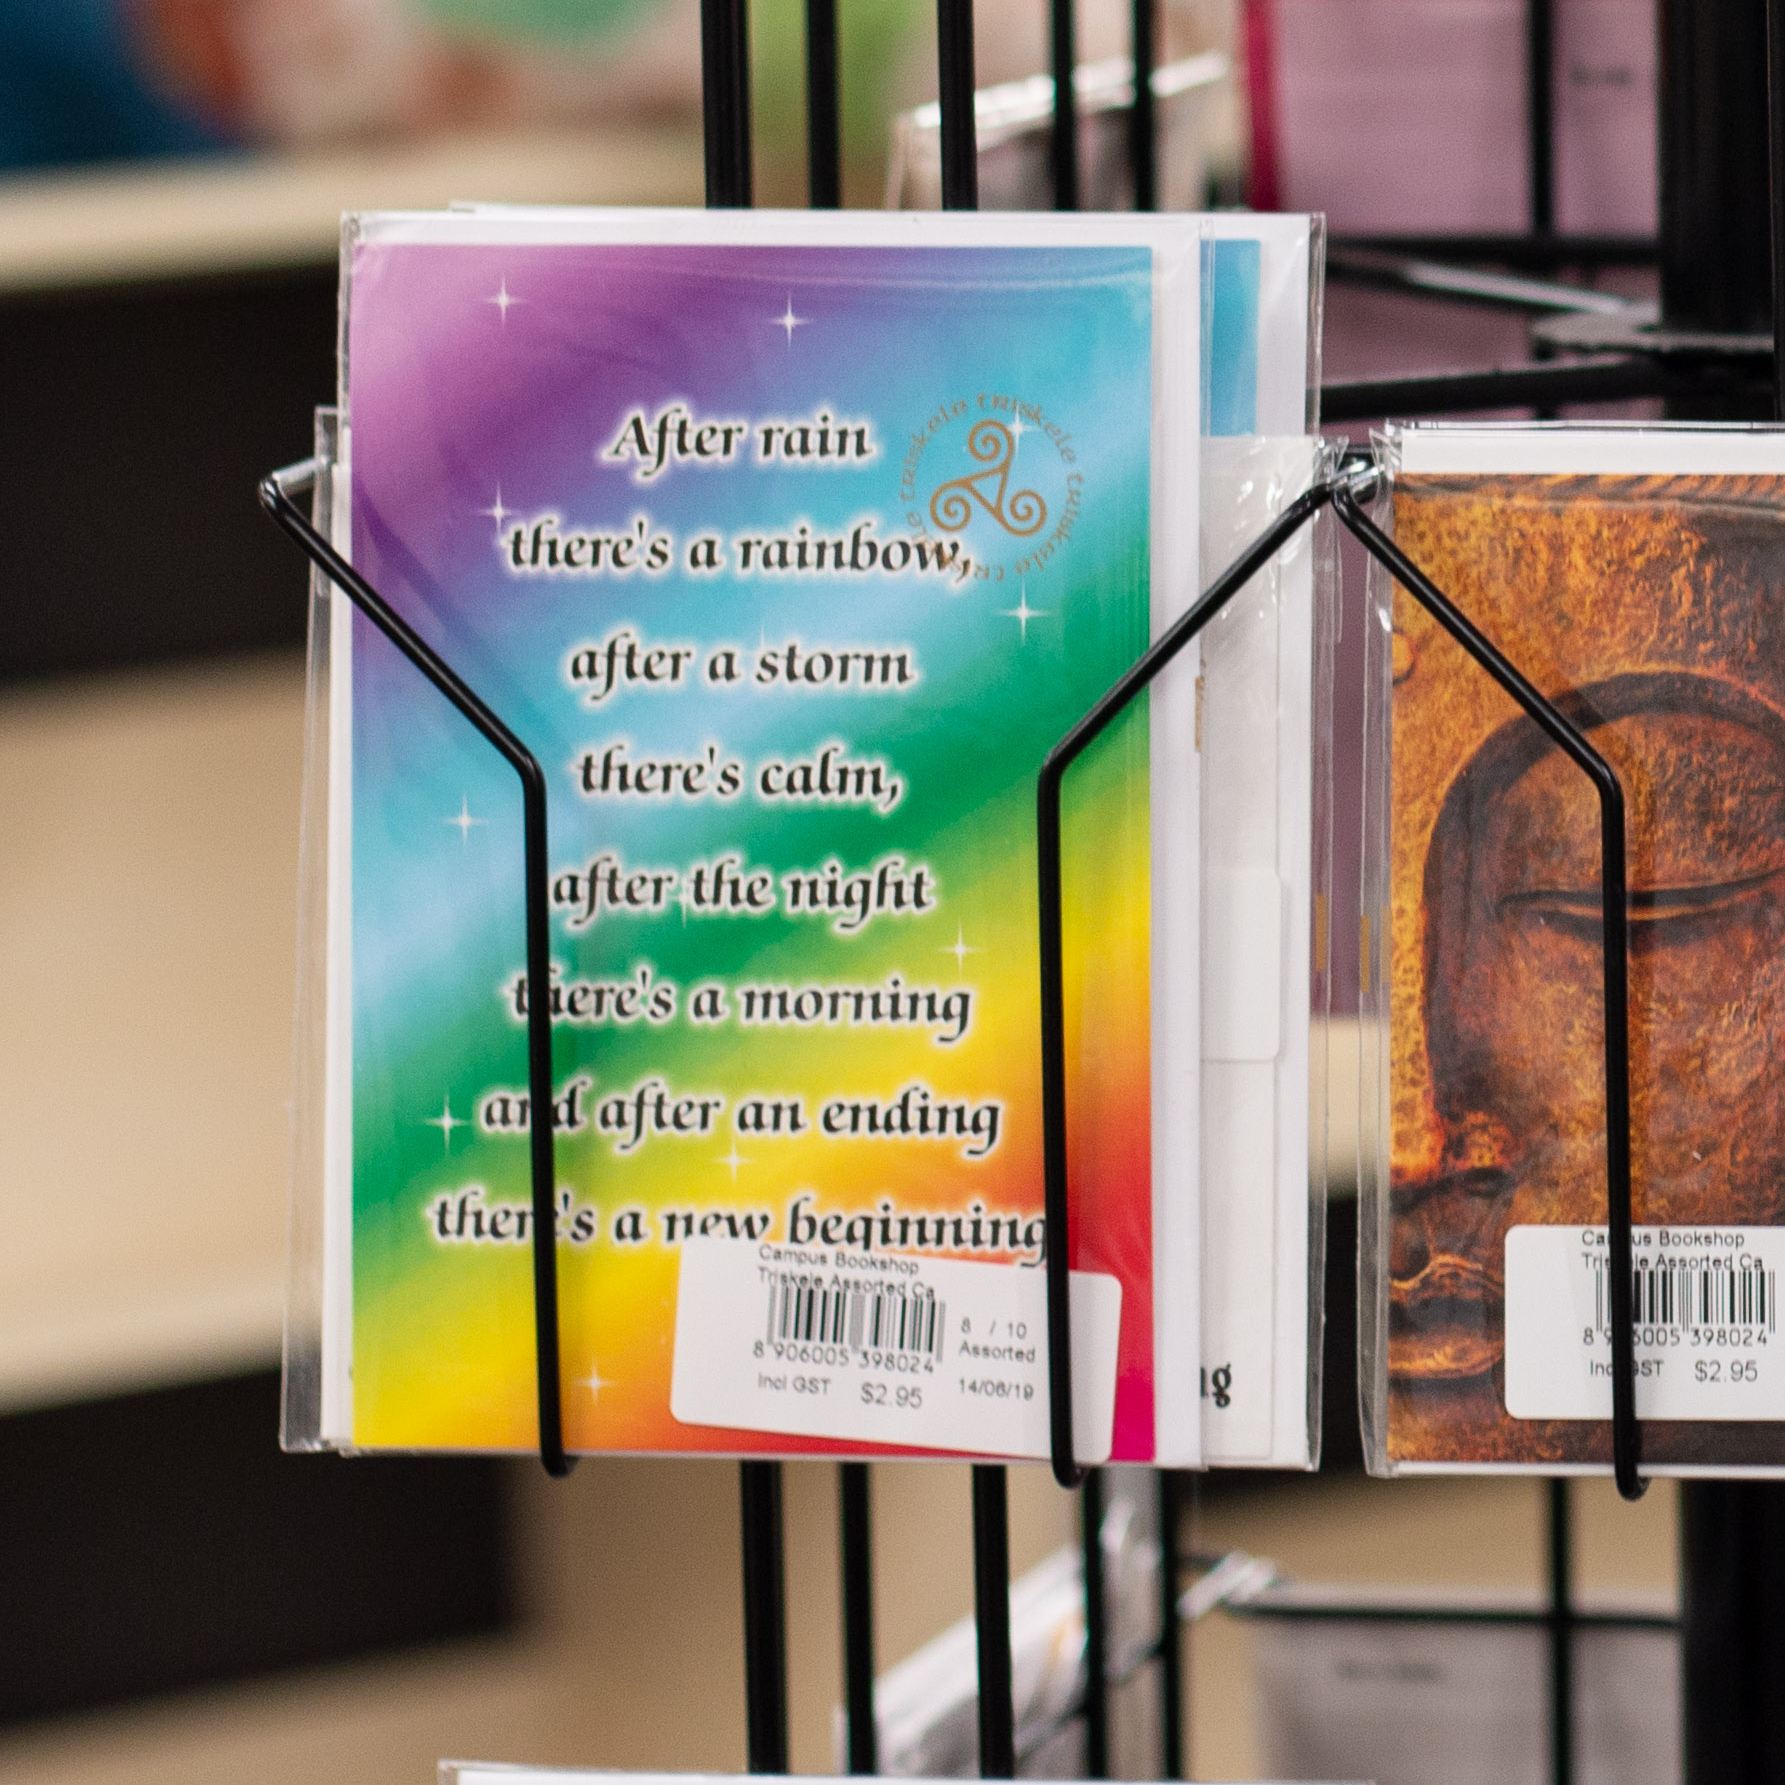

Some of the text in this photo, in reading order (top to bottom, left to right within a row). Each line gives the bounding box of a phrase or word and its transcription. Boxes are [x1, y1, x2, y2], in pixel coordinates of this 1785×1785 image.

[607, 406, 872, 479] After rain
[506, 517, 972, 584] there's a rainbow,
[569, 632, 915, 701] after a storm
[576, 744, 902, 808] there's calm,
[552, 856, 935, 929] after the night
[691, 988, 727, 1018] a
[739, 978, 972, 1043] morning
[598, 1081, 723, 1151] after
[735, 1101, 809, 1134] an
[821, 1084, 1003, 1157] ending
[427, 1184, 596, 1243] ther's
[612, 1208, 651, 1243] a
[661, 1208, 770, 1244] new
[1581, 1229, 1746, 1250] Caus Bookshop
[758, 1243, 920, 1275] Campus Bookshop
[1581, 1252, 1764, 1271] Trisle Assorted Ca
[757, 1265, 823, 1289] Triskele
[830, 1273, 906, 1298] Assorted
[961, 1316, 971, 1334] 8
[1007, 1321, 1028, 1340] 10
[1583, 1327, 1768, 1347] 8 96005 398024
[752, 1340, 935, 1374] 8 906005 398024
[960, 1340, 1036, 1363] Assorted
[758, 1371, 832, 1395] Incl GST
[1694, 1359, 1759, 1383] $2.95
[860, 1381, 923, 1409] $2.95
[959, 1377, 1035, 1401] 14/06/19
